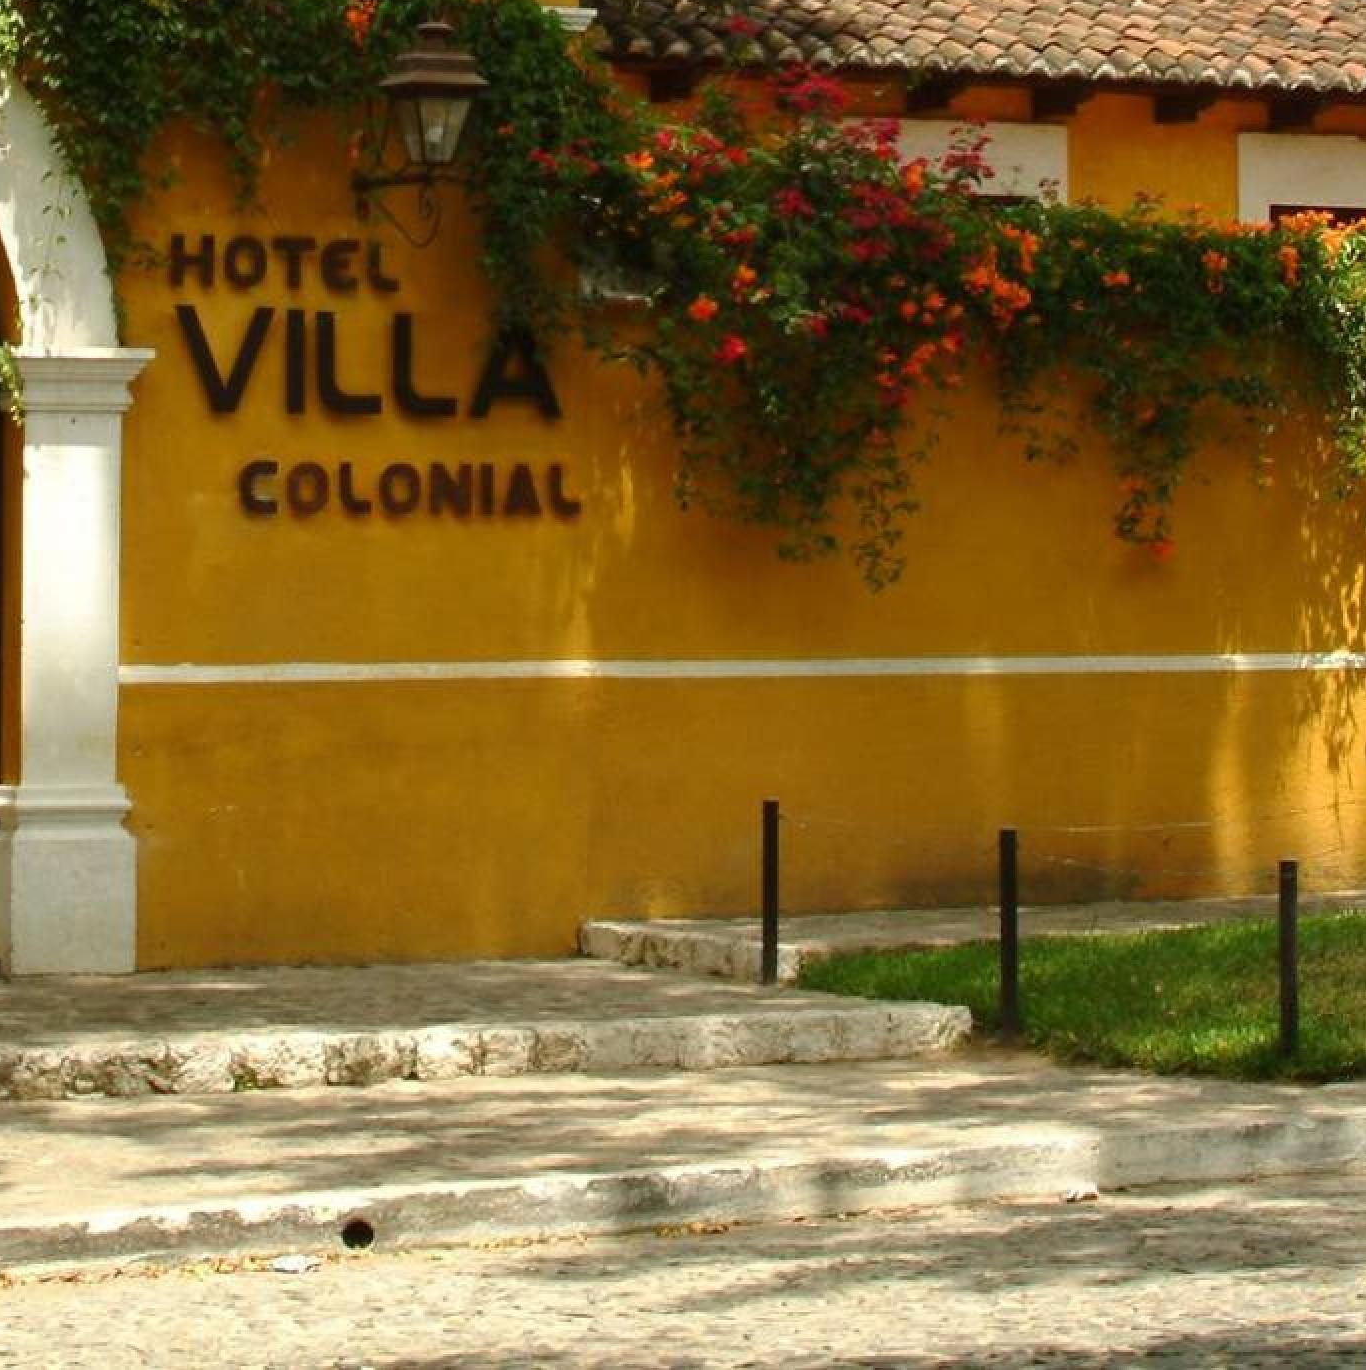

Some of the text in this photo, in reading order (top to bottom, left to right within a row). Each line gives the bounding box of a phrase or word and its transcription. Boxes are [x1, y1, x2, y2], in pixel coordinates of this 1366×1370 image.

[168, 234, 399, 293] HOTEL
[175, 304, 562, 418] VILLA
[239, 459, 581, 518] COLONIAL
